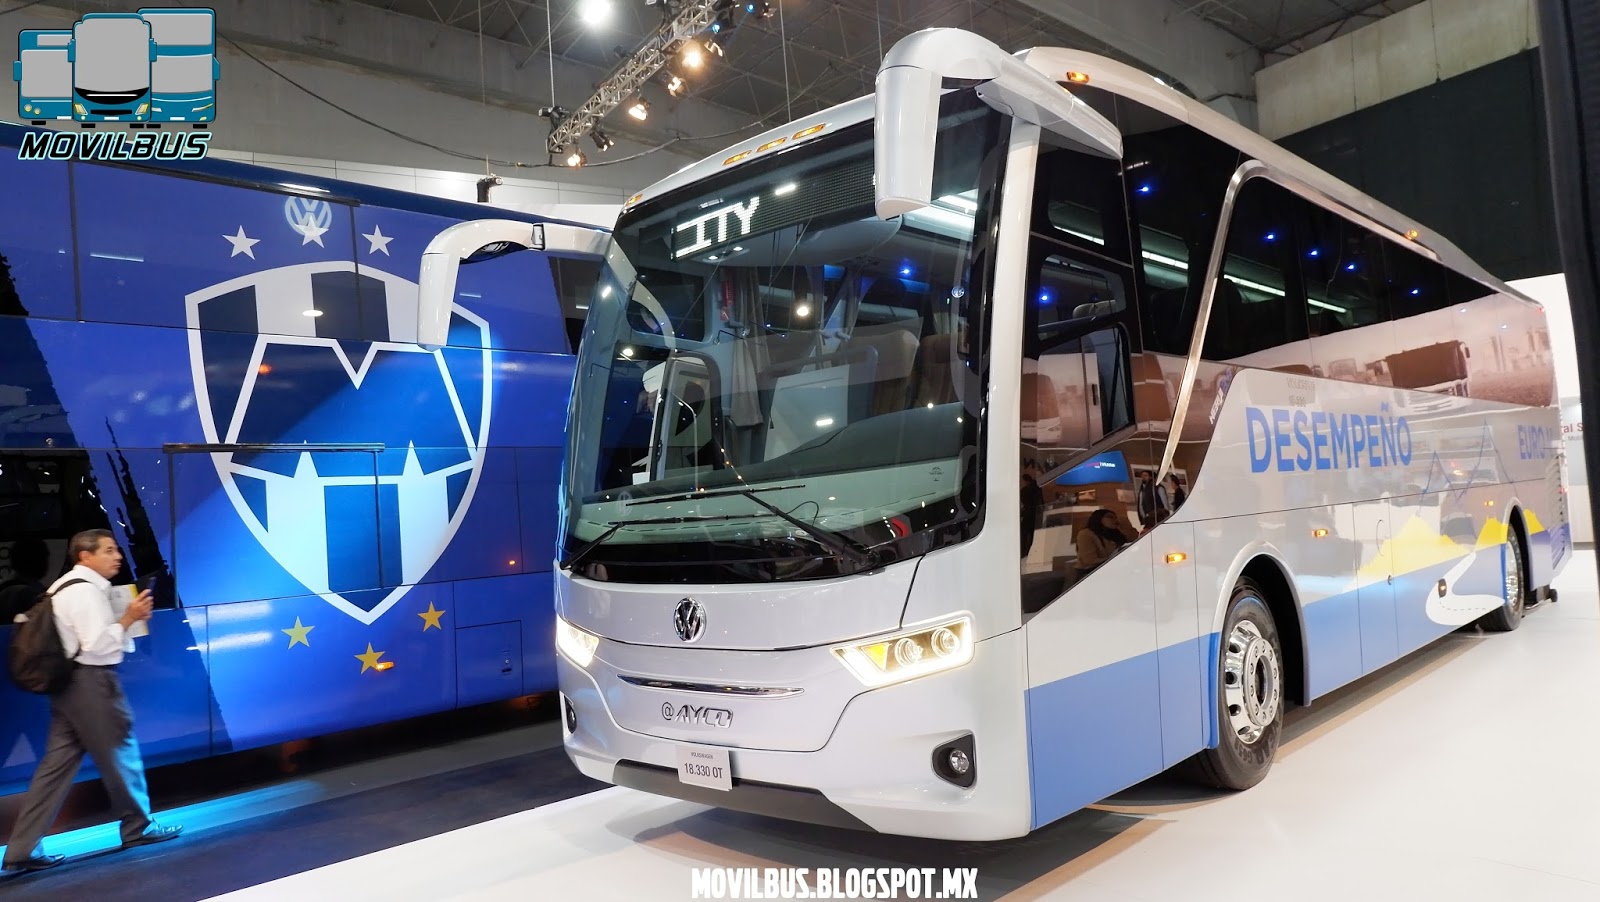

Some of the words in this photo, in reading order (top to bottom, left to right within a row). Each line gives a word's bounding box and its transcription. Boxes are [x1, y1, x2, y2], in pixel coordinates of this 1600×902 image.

[1245, 402, 1413, 473] DESEMPEÑO
[684, 762, 711, 777] 18.330
[712, 766, 723, 779] OT
